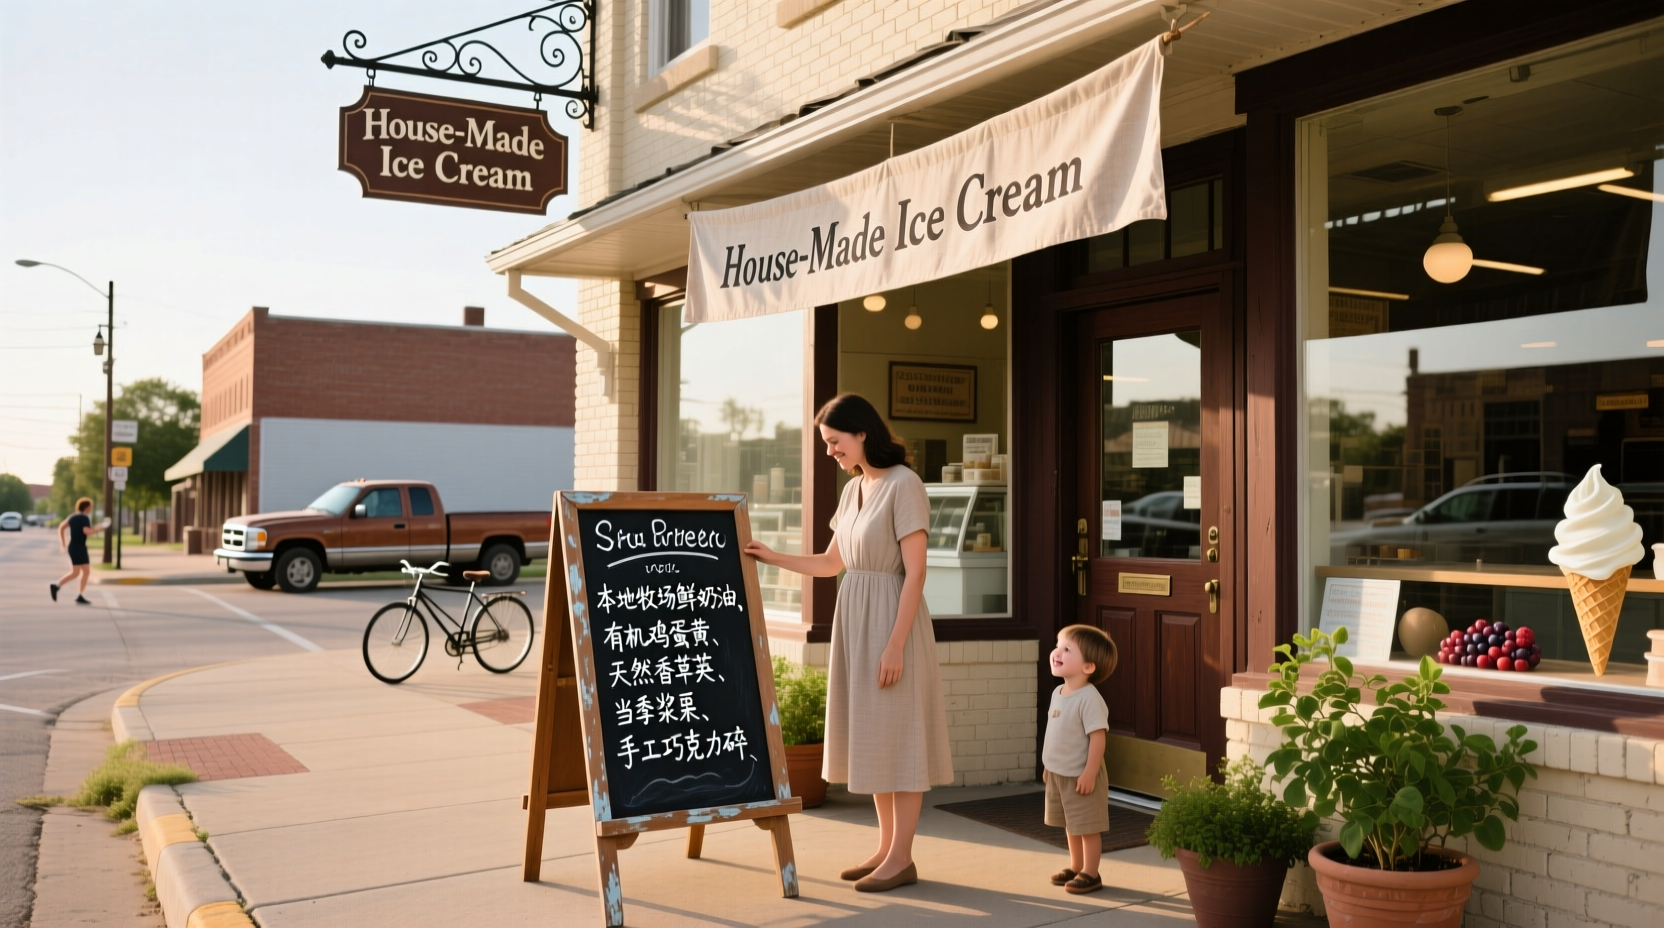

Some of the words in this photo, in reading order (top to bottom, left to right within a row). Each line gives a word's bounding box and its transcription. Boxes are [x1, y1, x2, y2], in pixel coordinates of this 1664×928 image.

[362, 108, 545, 160] House-Made
[379, 145, 424, 179] Ice
[435, 151, 533, 192] Cream
[719, 212, 886, 289] House-Made
[894, 198, 945, 252] Ice
[956, 156, 1083, 232] Cream
[597, 583, 744, 614] 本地牧场鲜奶油、
[603, 617, 719, 652] 有机鸡蛋黄、
